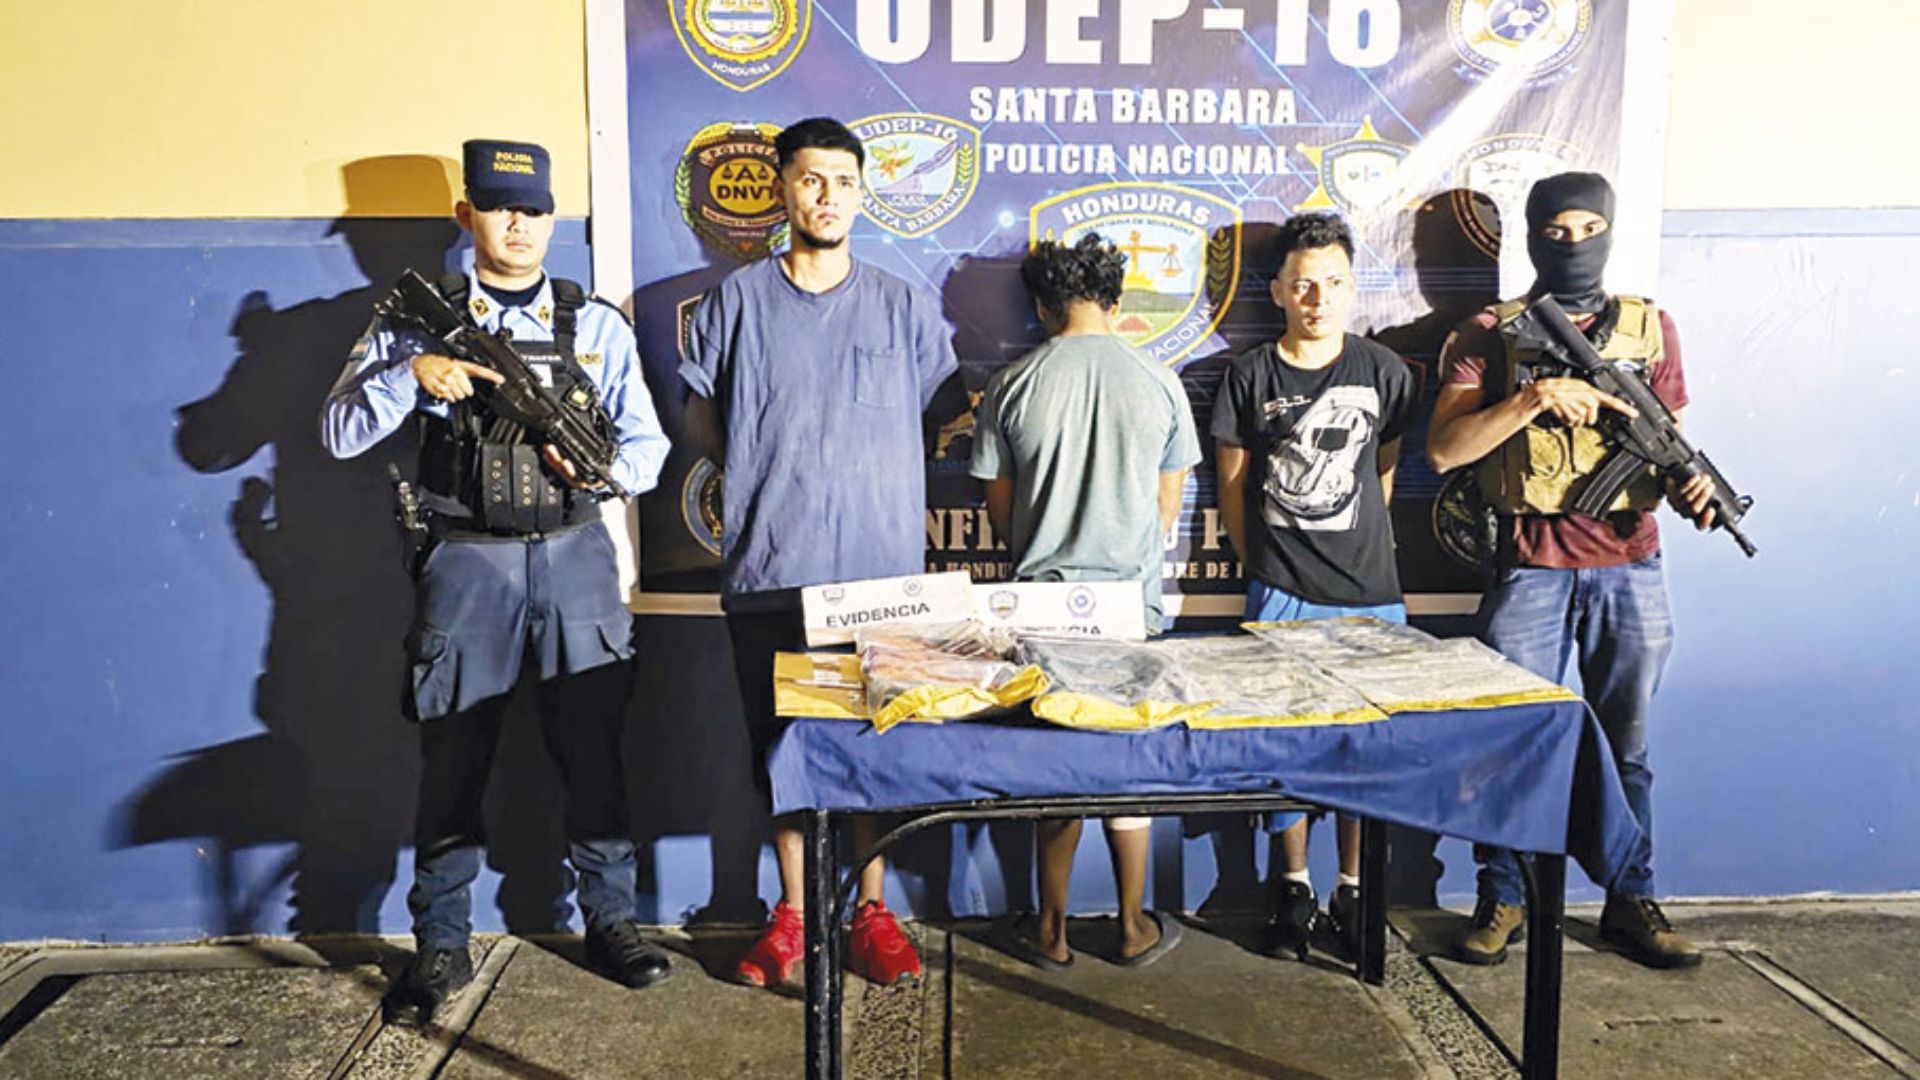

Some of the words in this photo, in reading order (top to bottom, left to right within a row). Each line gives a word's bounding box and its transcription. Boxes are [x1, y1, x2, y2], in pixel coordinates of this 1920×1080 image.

[711, 60, 771, 77] HONDURAS
[969, 86, 1102, 124] SANTA
[1111, 88, 1298, 125] BARBARA
[854, 117, 959, 141] UDEP-16
[985, 143, 1116, 175] POLICIA
[1128, 144, 1292, 175] NACIONAL
[862, 191, 901, 229] ANTA
[1061, 192, 1210, 229] HONDURAS
[946, 561, 1011, 579] HONDU
[1205, 561, 1230, 579] DE
[825, 602, 931, 628] EVIDENCIA
